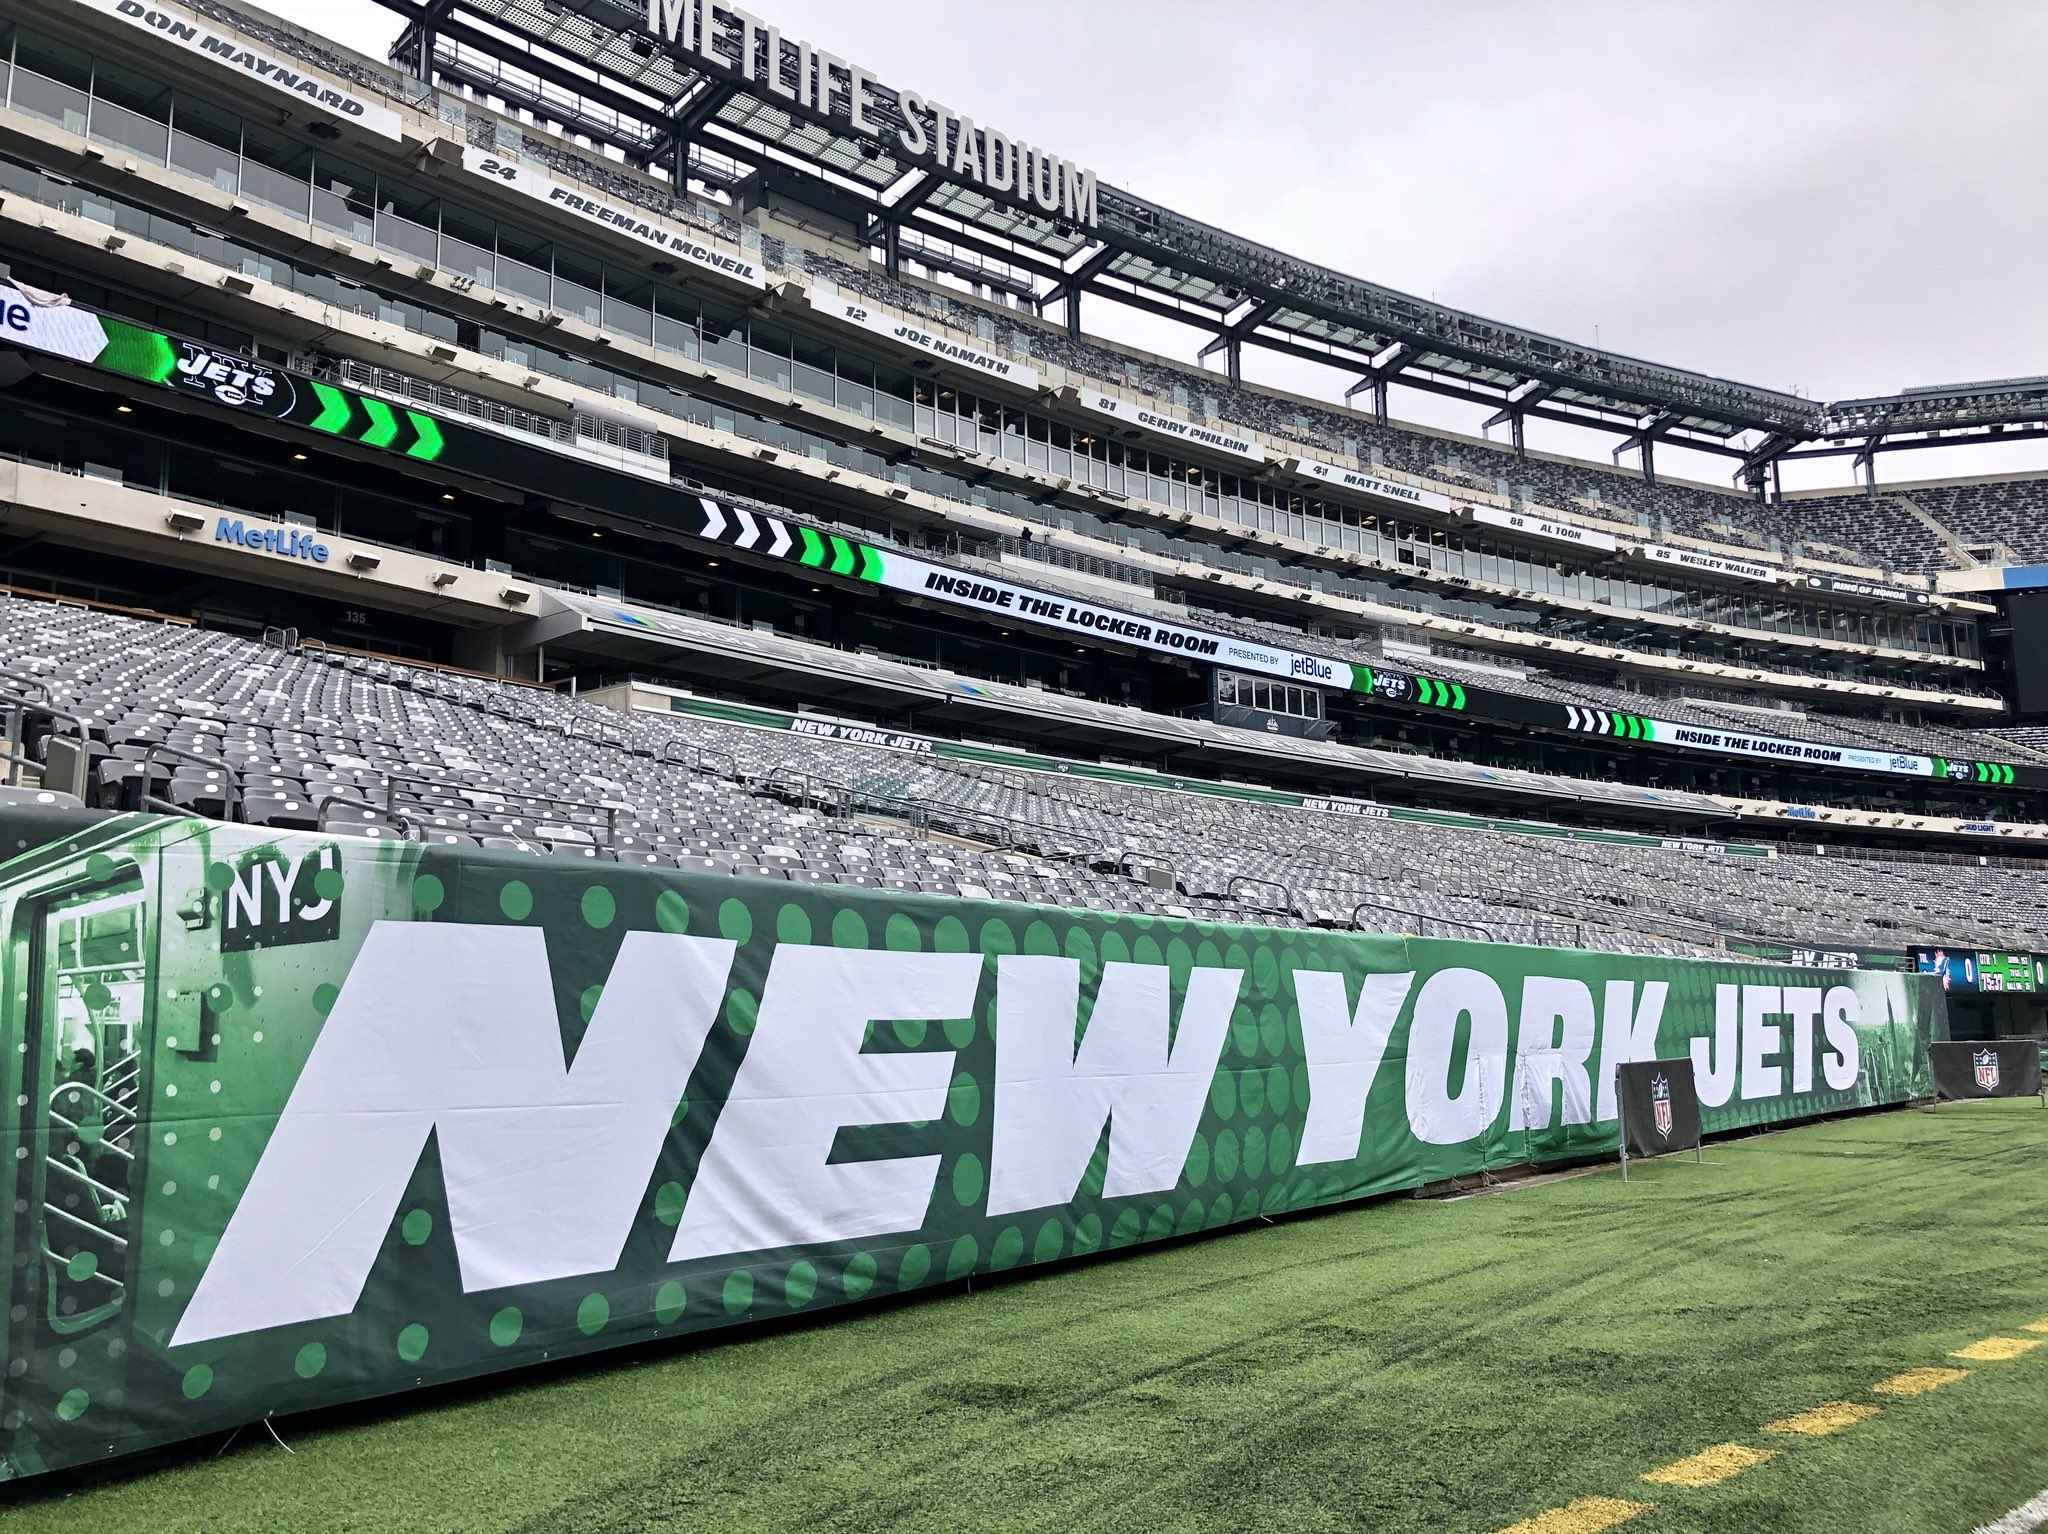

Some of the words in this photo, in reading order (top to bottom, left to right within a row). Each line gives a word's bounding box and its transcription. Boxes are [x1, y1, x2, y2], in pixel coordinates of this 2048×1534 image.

[115, 0, 198, 42] DON
[199, 35, 365, 117] MAYNARD
[647, 0, 878, 137] METLIFE
[898, 89, 1098, 228] STADIUM
[479, 158, 517, 182] 24
[549, 187, 668, 245] FREEMAN
[670, 237, 755, 280] MCNEIL
[845, 306, 867, 322] 12
[894, 326, 932, 346] JOE
[933, 340, 1010, 375] NAMATH
[177, 353, 276, 396] JETS
[1099, 398, 1117, 412] 81
[1138, 411, 1189, 434] GERRY
[1189, 427, 1249, 453] PHILBIN
[1313, 465, 1328, 476] 41
[1344, 474, 1381, 490] MATT
[1382, 484, 1421, 501] SNELL
[215, 516, 330, 563] MetLife
[1510, 517, 1524, 527] 88
[1540, 524, 1553, 533] AL
[1555, 527, 1582, 539] TOON
[1656, 549, 1671, 559] 85
[1680, 553, 1723, 568] WESLEY
[1725, 562, 1767, 578] WALKER
[1833, 580, 1858, 592] RING
[1858, 585, 1872, 595] OF
[1872, 588, 1907, 600] HONOR
[346, 611, 366, 624] 135
[924, 572, 1014, 608] INSIDE
[1017, 595, 1065, 620] THE
[1066, 608, 1152, 641] LOCKER
[1153, 629, 1220, 656] ROOM
[1228, 647, 1269, 663] PRESENTED
[1269, 656, 1279, 666] BY
[1290, 653, 1332, 679] jetBlue
[1373, 674, 1406, 690] JETS
[790, 718, 837, 737] NEW
[839, 726, 889, 745] YORK
[889, 736, 933, 751] JETS
[1675, 729, 1721, 746] INSIDE
[1724, 736, 1750, 750] THE
[1751, 740, 1801, 756] LOCKER
[1803, 749, 1842, 762] ROOM
[1889, 755, 1918, 770] jetBlue
[1947, 762, 1969, 773] JETS
[1302, 798, 1330, 810] NEW
[1330, 801, 1361, 814] YORK
[1362, 806, 1389, 817] JETS
[1661, 840, 1682, 849] NEW
[1682, 842, 1705, 851] YORK
[227, 847, 334, 929] NYJ
[1964, 957, 1974, 983] 0
[2036, 961, 2045, 985] 0
[1976, 1067, 1997, 1085] NFL
[168, 919, 1245, 1347] NEW
[1292, 967, 1670, 1166] YORK
[1689, 983, 1860, 1108] JETS
